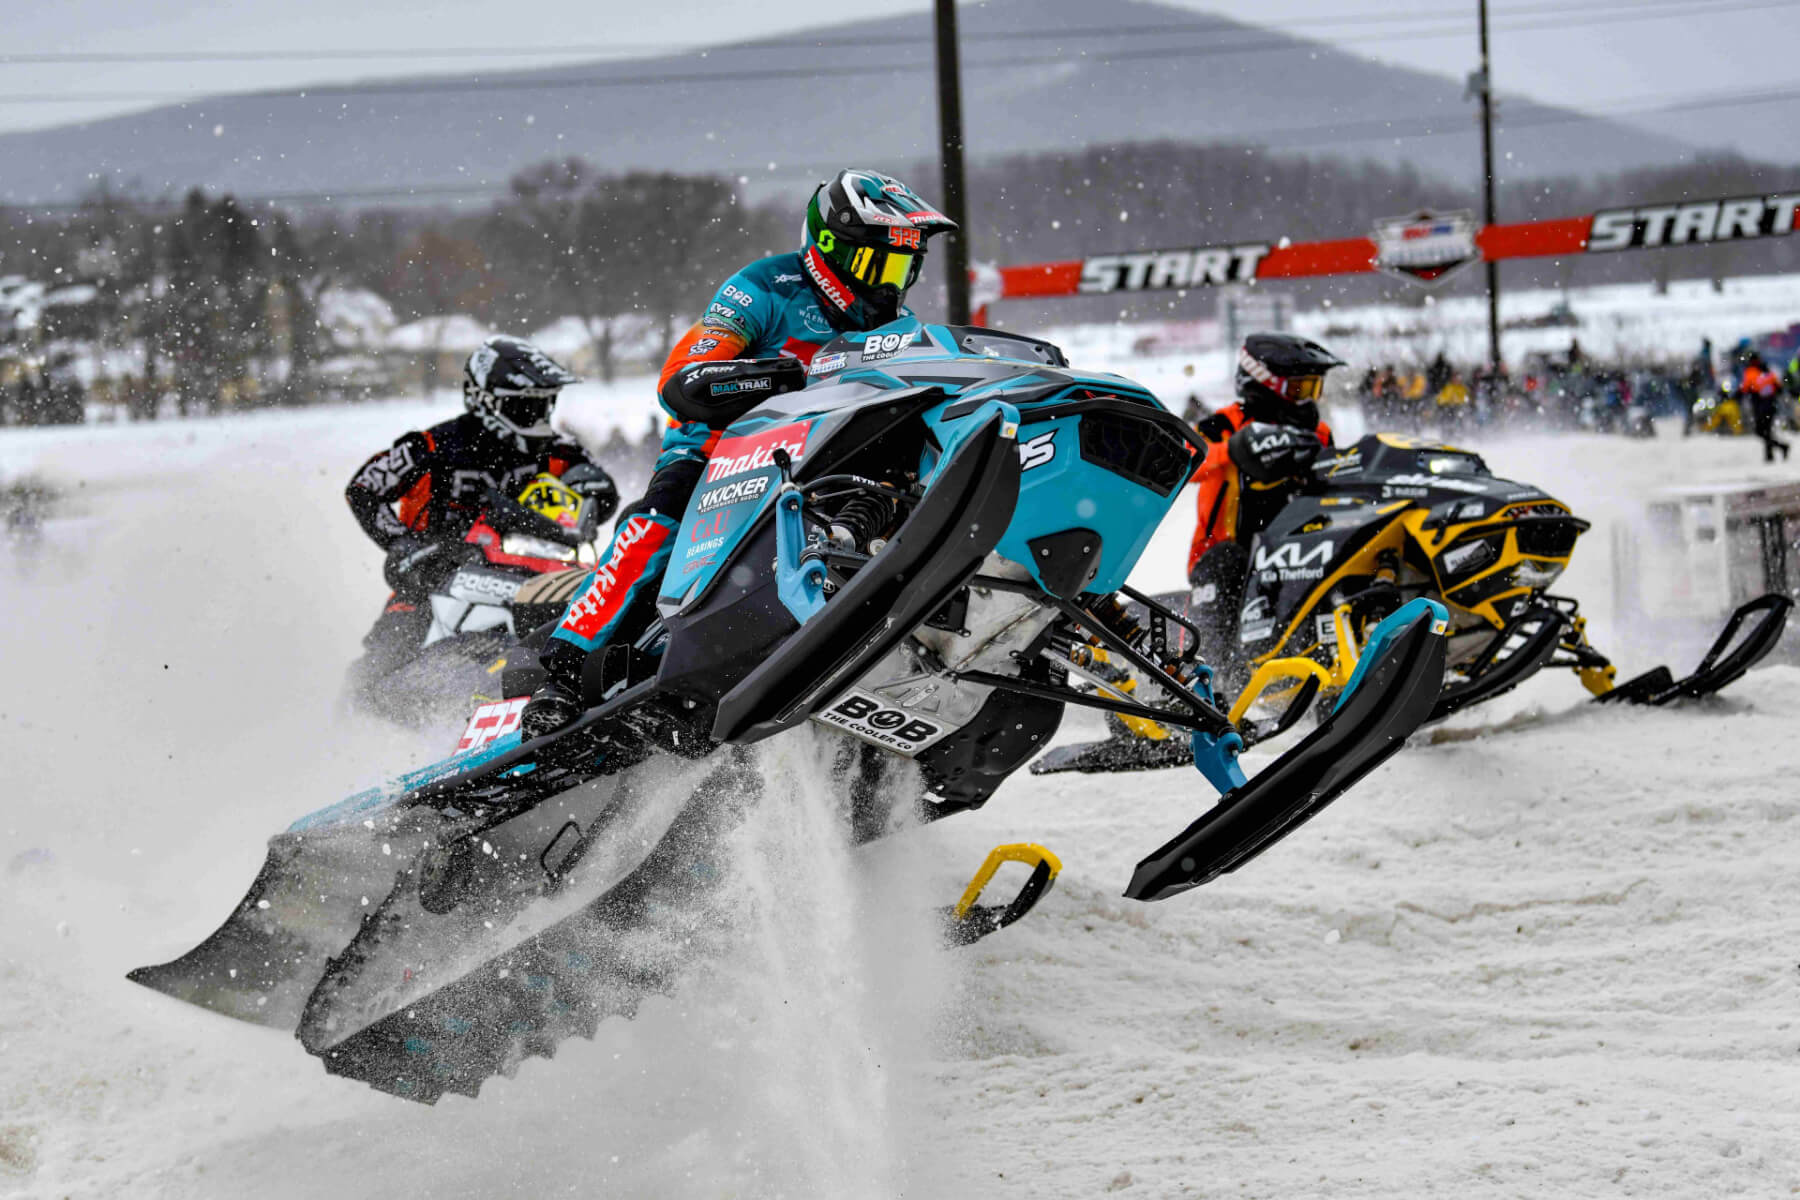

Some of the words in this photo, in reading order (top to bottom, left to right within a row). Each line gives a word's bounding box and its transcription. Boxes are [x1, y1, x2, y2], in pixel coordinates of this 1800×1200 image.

[888, 226, 921, 250] 522
[1588, 196, 1800, 252] START
[803, 249, 847, 312] makita
[1080, 245, 1269, 293] START
[723, 285, 753, 307] BOB
[707, 476, 769, 506] KICKER
[691, 510, 730, 543] C&U
[686, 537, 724, 558] BEARINGS
[453, 572, 518, 598] POLAR
[568, 517, 653, 627] makita
[824, 712, 849, 725] THE
[850, 723, 896, 744] COOLER
[897, 741, 913, 750] CO
[832, 695, 938, 742] BOB
